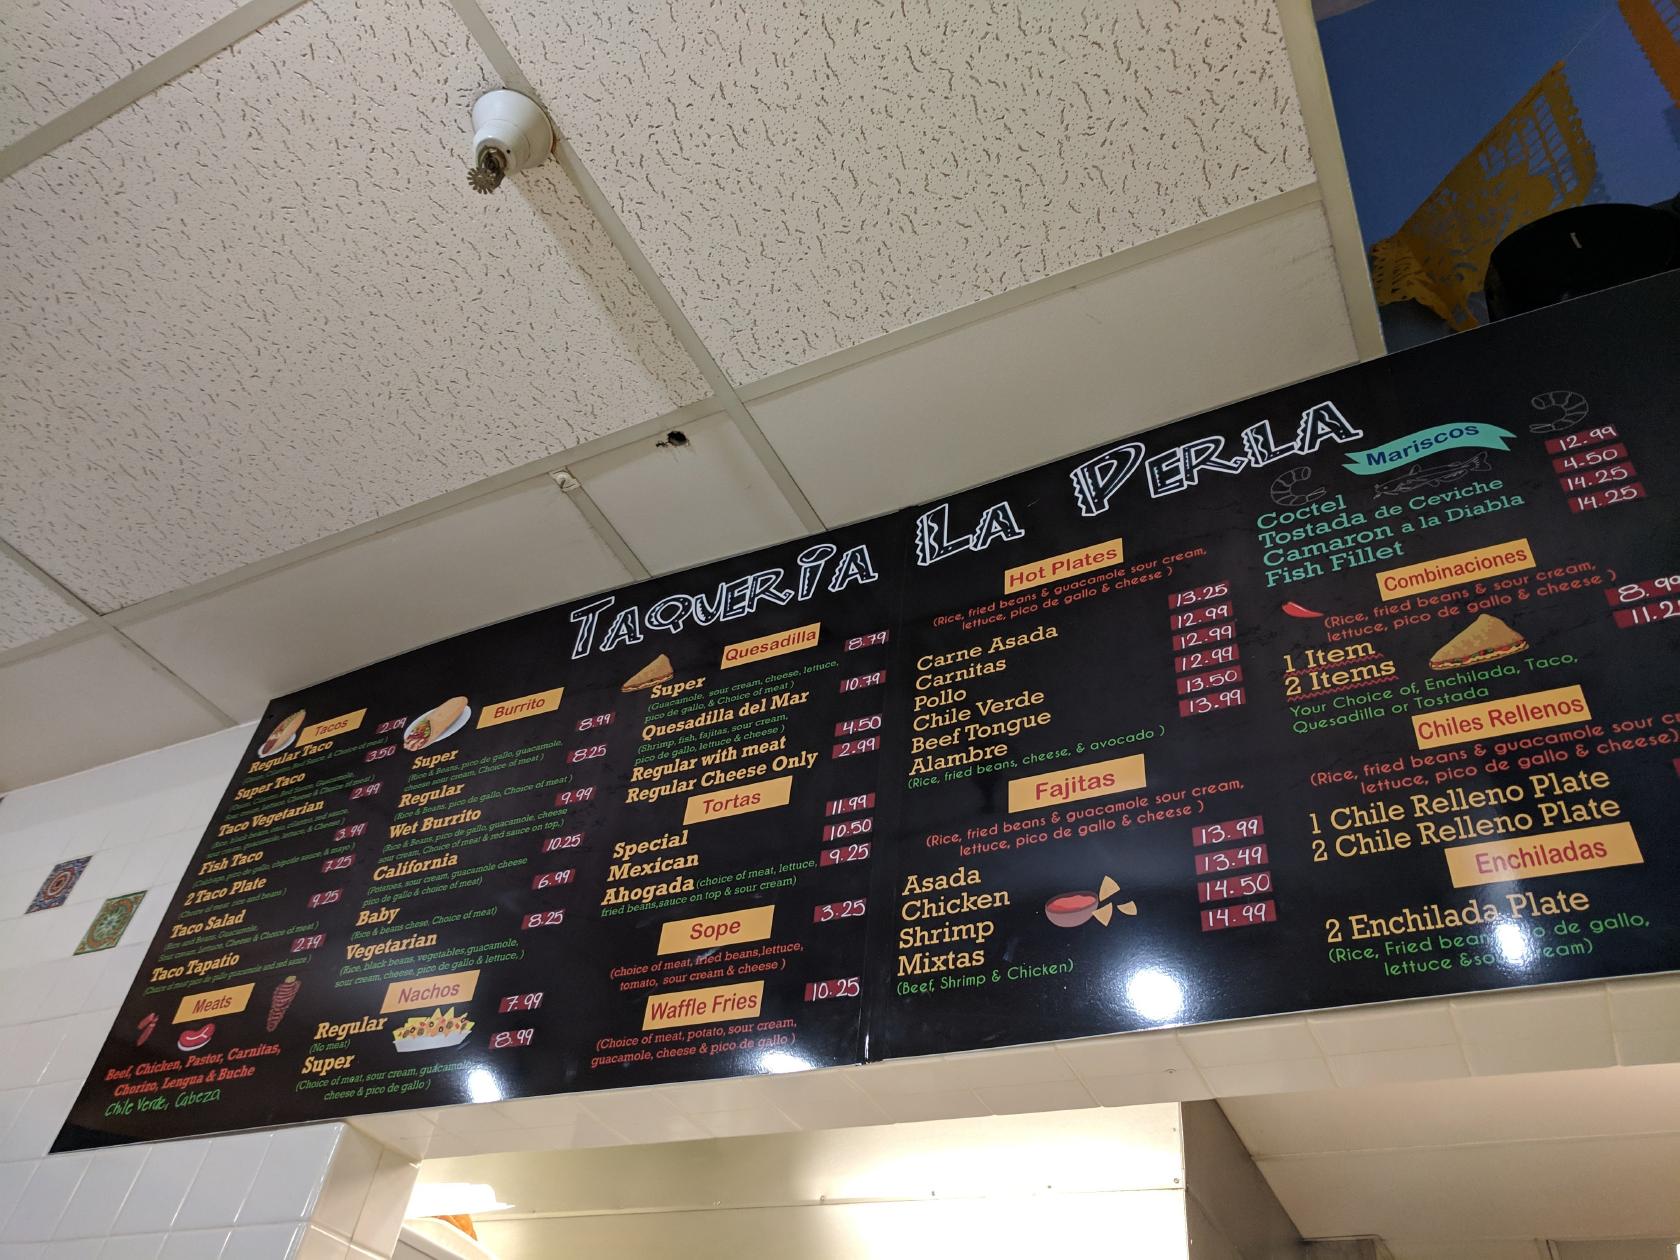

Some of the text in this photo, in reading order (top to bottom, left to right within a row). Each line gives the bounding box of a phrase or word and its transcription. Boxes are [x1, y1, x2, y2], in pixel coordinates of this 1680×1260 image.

[1367, 425, 1480, 468] Mariscos
[1559, 427, 1616, 450] 12.99
[915, 401, 1363, 567] LA PERLA
[1567, 467, 1628, 490] 14.25
[1257, 495, 1347, 529] Coctel
[1578, 486, 1638, 510] 14.25
[1258, 479, 1504, 548] Tostada de Ceviche
[1262, 493, 1525, 567] Camaron a la Diabla
[1009, 548, 1118, 588] Hot Plates
[1265, 541, 1404, 588] Fish Fillet
[1384, 547, 1528, 592] Combinaciones
[1176, 583, 1228, 607] 13.25
[1178, 605, 1229, 628] 12.99
[725, 629, 816, 662] Quesadilla
[848, 632, 887, 650] 8.79
[916, 625, 1058, 672] Carne Asada
[1181, 625, 1233, 649] 12.99
[1182, 647, 1234, 671] 12.99
[1283, 639, 1375, 672] 1 Item
[650, 676, 706, 700] Super
[844, 673, 881, 691] 10.79
[915, 658, 1007, 691] Carnitas
[1186, 670, 1237, 693] 13.50
[1285, 658, 1396, 696] 2 Items
[1290, 652, 1578, 718] Your Choice of, Enchilada, Taco,
[494, 697, 545, 719] Burrito
[913, 690, 1045, 732] Chile Verde
[914, 689, 967, 712] Pollo
[1189, 690, 1241, 714] 13.99
[1292, 686, 1489, 735] Quesadilla or Tostada
[314, 719, 348, 737] Tacos
[578, 714, 611, 731] 8.99
[641, 692, 809, 741] Quesadilla del Mar
[842, 716, 882, 733] 4.50
[1418, 695, 1584, 742] Chiles Rellenos
[911, 711, 1051, 755] Beef Tongue
[248, 741, 334, 773] Regular Taco
[411, 750, 459, 770] Super
[630, 735, 787, 783] Regular with meat
[838, 738, 876, 758] 2.99
[908, 729, 1154, 789] (Rice, fried beans, cheese, & avocado
[908, 743, 1008, 776] Alambre
[234, 781, 275, 801] Super
[276, 773, 306, 789] Taco
[625, 750, 818, 804] Regular Cheese Only
[1035, 771, 1115, 801] Fajitas
[398, 783, 465, 808] Regular
[561, 787, 593, 805] 9.99
[703, 791, 761, 815] Tortas
[832, 795, 867, 815] 11.99
[1310, 768, 1611, 834] 1 Chile Relleno Plate
[218, 820, 249, 837] Taco
[252, 801, 324, 828] Vegetarian
[389, 808, 482, 839] Wet Burrito
[830, 819, 872, 838] 10.50
[1201, 819, 1259, 845] 13.99
[1312, 798, 1621, 862] 2 Chile Relleno Plate
[546, 836, 582, 852] 10.25
[613, 830, 689, 861] Special
[829, 844, 869, 863] 9.25
[1475, 840, 1608, 875] Enchiladas
[198, 851, 264, 876] Fish Taco
[372, 853, 459, 881] California
[607, 854, 699, 881] Mexican
[1204, 847, 1263, 872] 13.49
[184, 893, 195, 907] 2
[196, 886, 226, 903] Taco
[231, 877, 267, 894] Plate
[537, 870, 571, 888] 6.99
[601, 877, 695, 906] Ahogada
[902, 866, 981, 896] Asada
[1205, 873, 1271, 902] 14.50
[355, 907, 400, 927] Baby
[528, 910, 564, 928] 8.25
[820, 900, 866, 921] 3.25
[901, 891, 1010, 922] Chicken
[1208, 903, 1267, 927] 14.99
[1326, 890, 1591, 943] 2 Enchilada Plate
[170, 923, 203, 938] Taco
[205, 909, 247, 930] Salad
[690, 920, 740, 941] Sope
[899, 919, 994, 950] Shrimp
[345, 933, 438, 961] Vegetarian
[150, 966, 184, 982] Taco
[188, 952, 240, 976] Tapatio
[897, 948, 985, 977] Mixtas
[812, 977, 861, 1002] 10.25
[897, 959, 1074, 996] (Beef, Shrimp & Chicken)
[192, 995, 232, 1014] Meats
[398, 982, 459, 1004] Nachos
[507, 992, 544, 1012] 7.99
[651, 993, 757, 1021] Waffle Fries
[314, 1016, 388, 1041] Regular
[495, 1029, 534, 1049] 8.99
[596, 1017, 797, 1051] (Choice of meat, potato, sour cream,
[105, 1043, 281, 1081] Beef, Chicken, Pastor, Carnitas,
[301, 1054, 355, 1076] Super
[114, 1065, 255, 1097] Chorizo, Lengua & Buche
